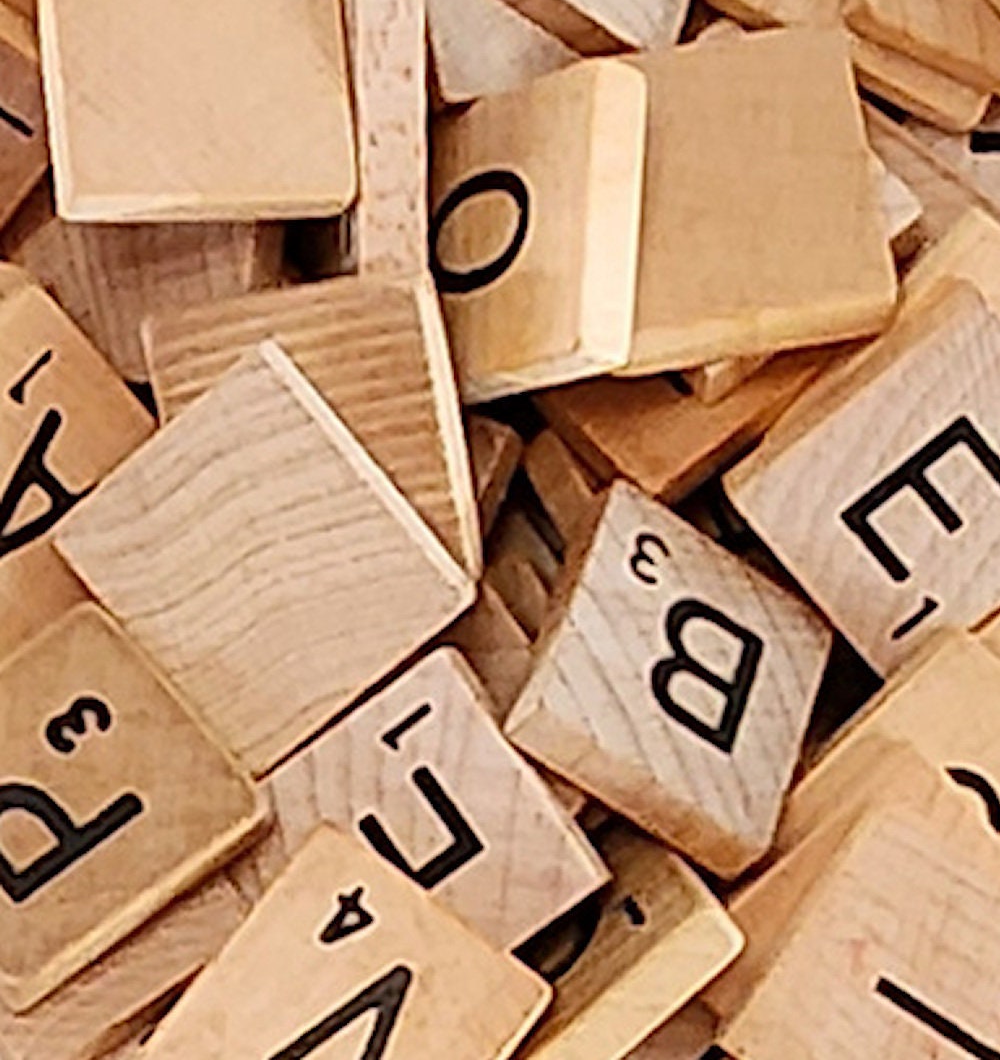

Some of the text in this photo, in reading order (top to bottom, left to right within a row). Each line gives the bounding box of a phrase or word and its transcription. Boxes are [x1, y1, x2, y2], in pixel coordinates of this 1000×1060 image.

[429, 170, 531, 294] O
[0, 350, 88, 554] A 1
[630, 533, 764, 755] B 3
[891, 597, 939, 640] 1
[381, 703, 432, 751] 1
[0, 696, 144, 904] P 3
[320, 887, 374, 944] 4
